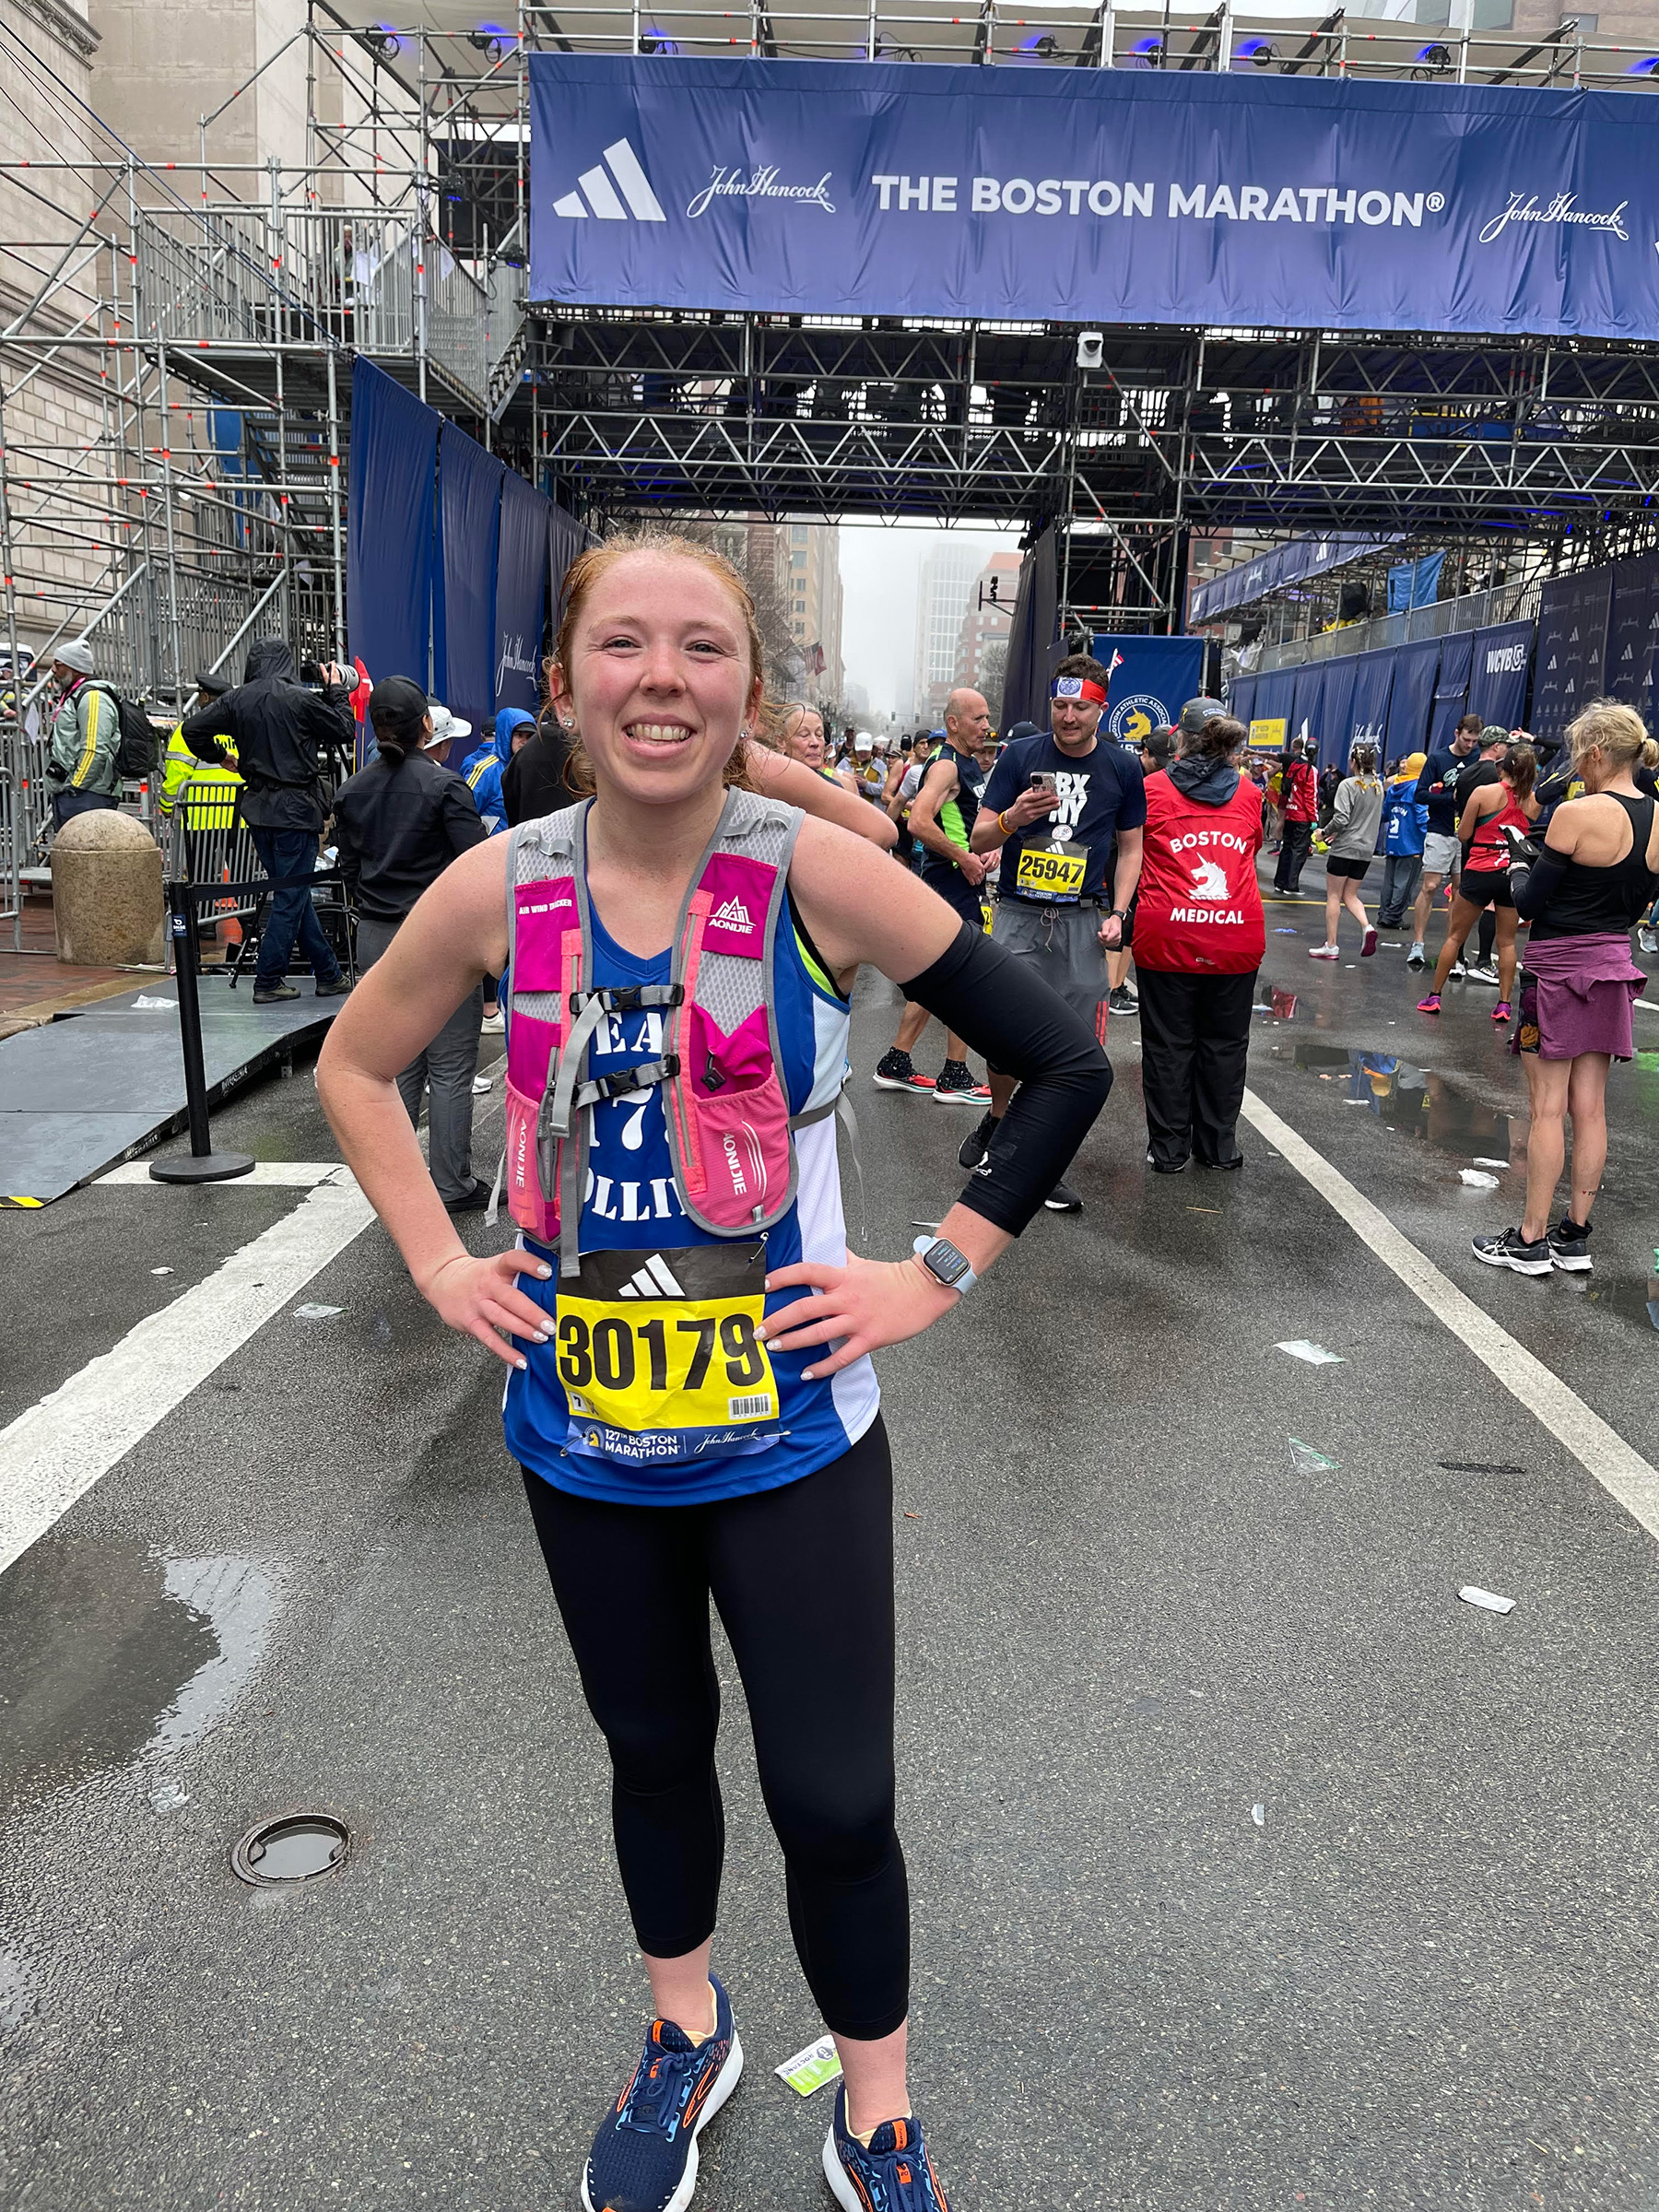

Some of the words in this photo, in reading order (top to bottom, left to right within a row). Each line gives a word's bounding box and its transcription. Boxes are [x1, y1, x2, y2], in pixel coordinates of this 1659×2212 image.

[687, 164, 746, 218] John
[745, 164, 837, 214] Hancock
[871, 175, 958, 212] THE
[971, 177, 1155, 218] BOSTON
[1478, 191, 1541, 243] John
[1541, 191, 1630, 241] Hancock
[1120, 697, 1149, 712] ATHLETIC
[1169, 830, 1248, 854] BOSTON
[1019, 854, 1085, 885] 25947
[519, 906, 530, 915] AIR
[530, 904, 548, 913] WIND
[1170, 907, 1244, 924] MEDICAL
[559, 1313, 765, 1391] 30179
[628, 1434, 677, 1448] BOSTON
